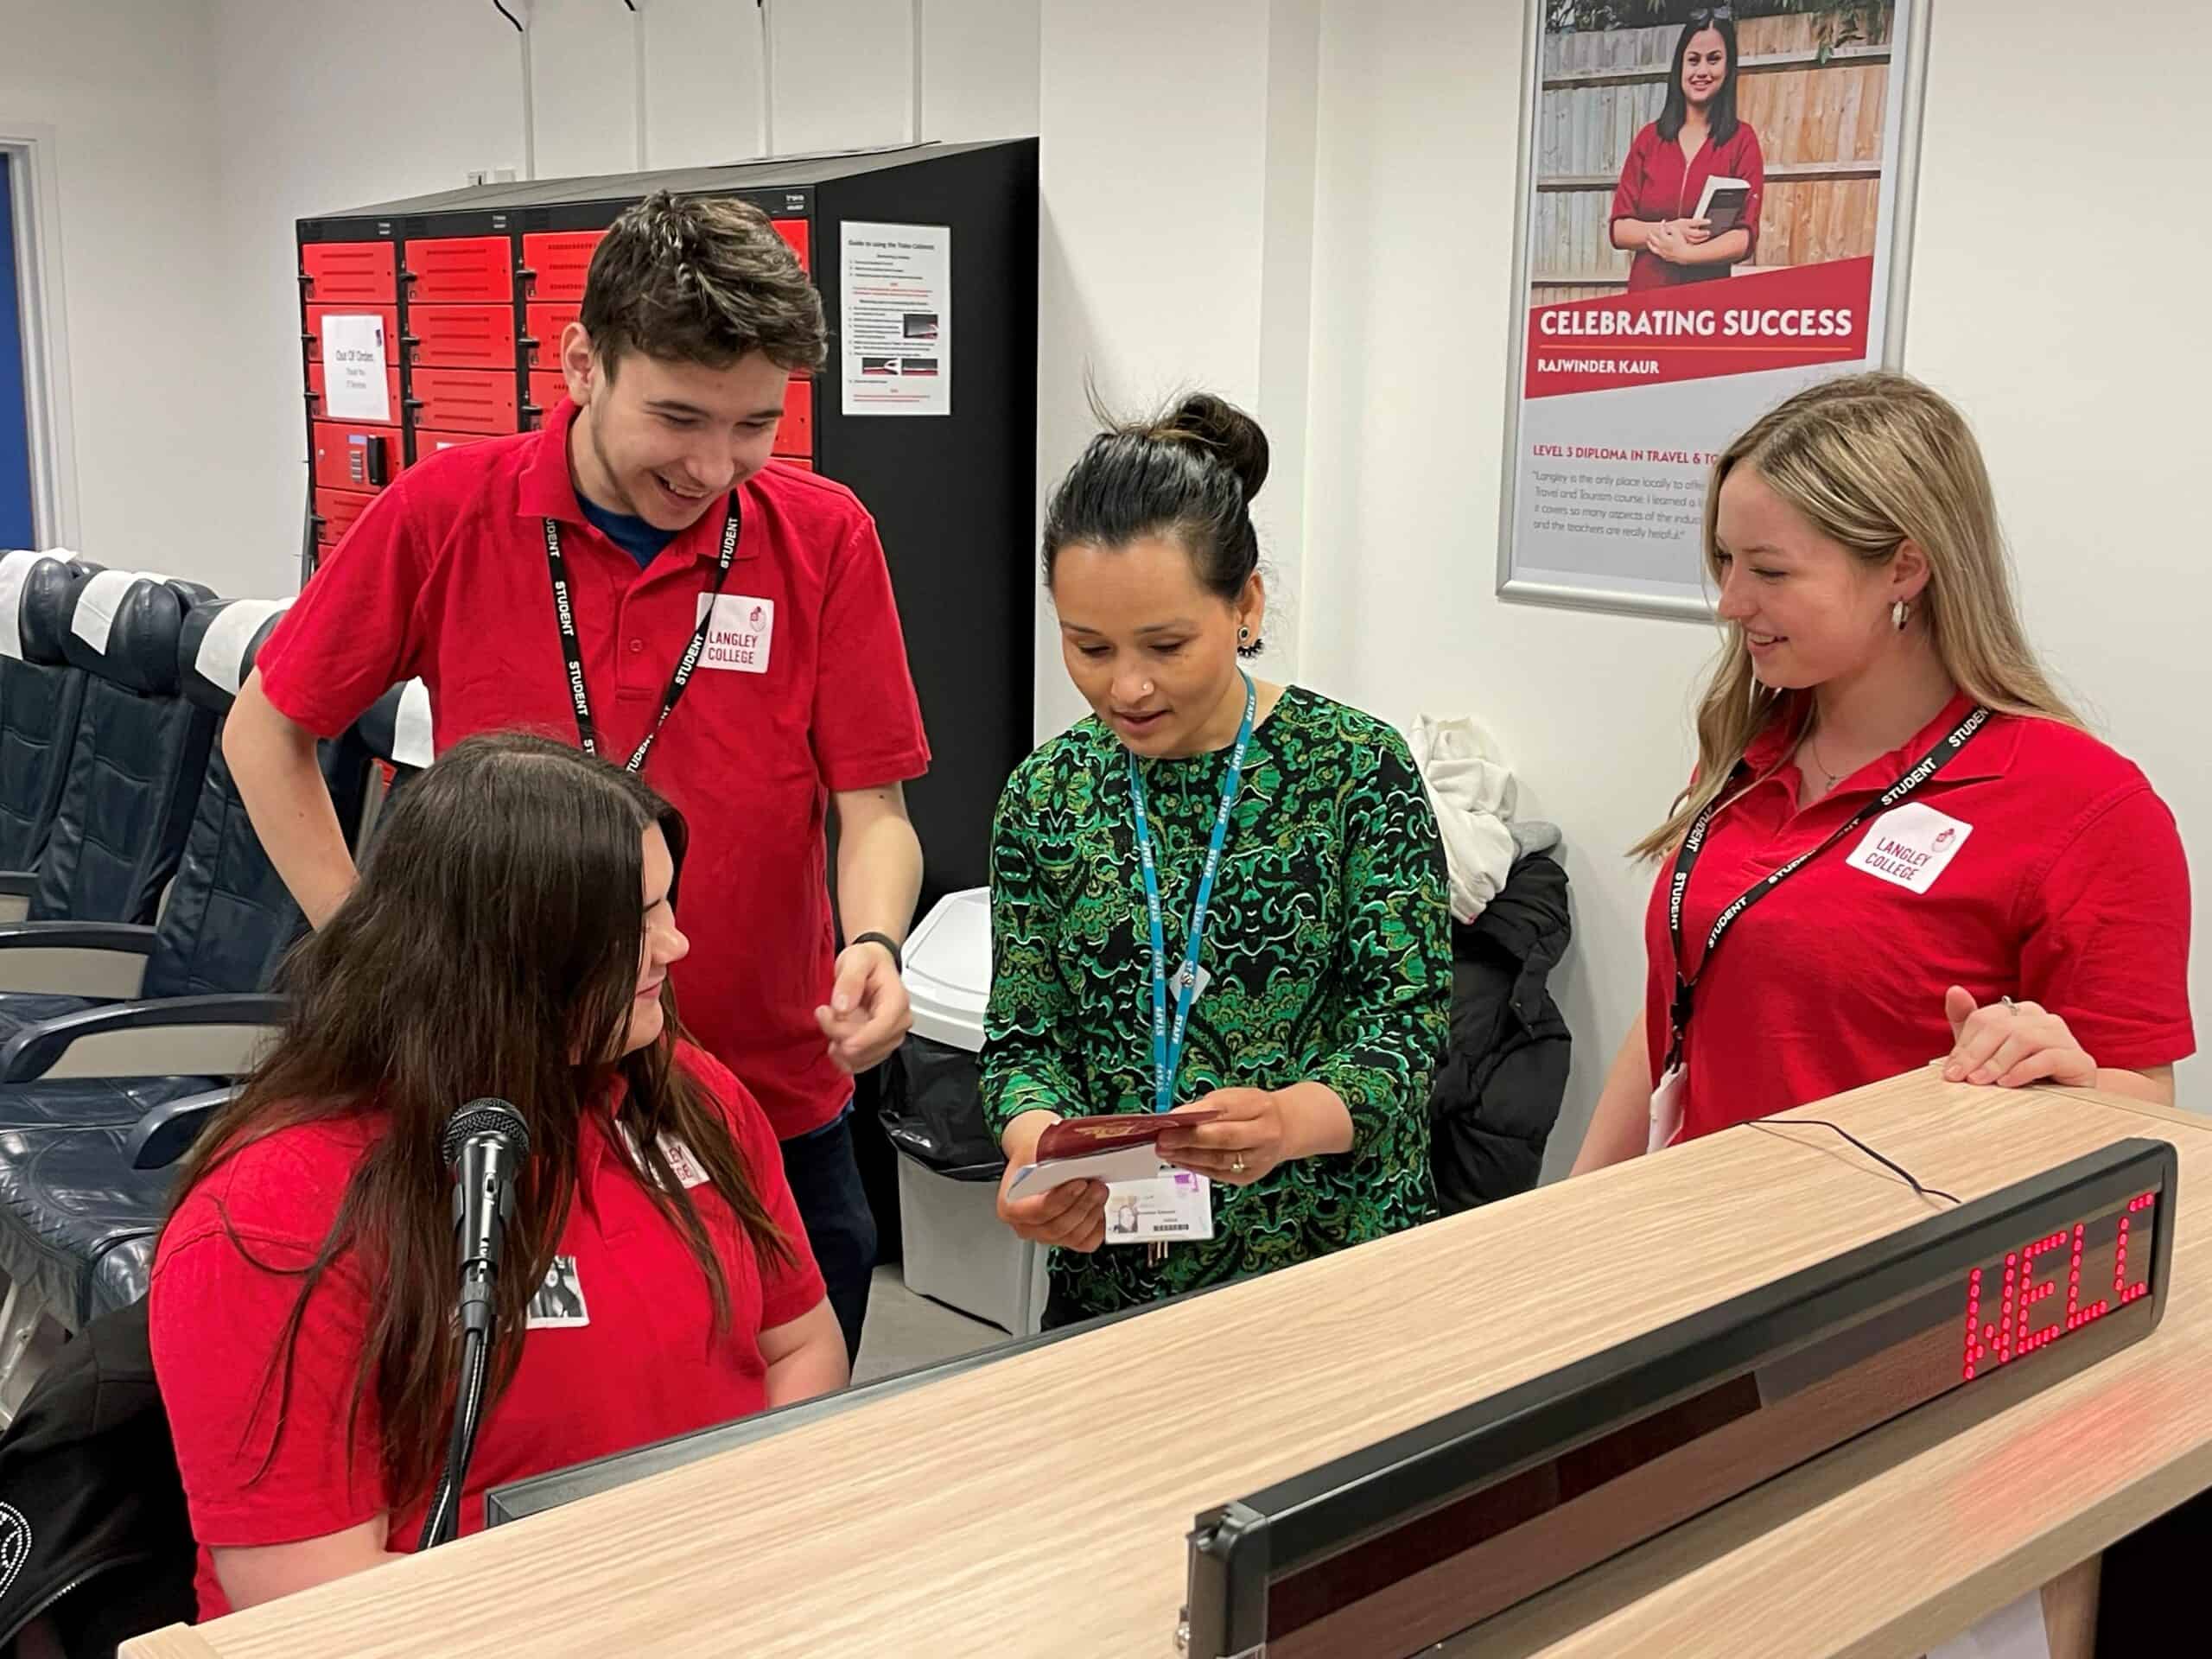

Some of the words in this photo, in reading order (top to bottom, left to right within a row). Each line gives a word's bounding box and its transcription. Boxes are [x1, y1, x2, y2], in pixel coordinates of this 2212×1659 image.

[1540, 310, 1715, 335] CELEBRATING
[1723, 309, 1853, 337] SUCCESS
[335, 349, 346, 361] Out
[1537, 359, 1616, 374] RAJWINDER
[1618, 360, 1659, 375] KAUR
[1533, 444, 1563, 458] LEVEL
[1575, 447, 1628, 461] DIPLOMA
[1630, 449, 1643, 461] IN
[1646, 450, 1689, 464] TRAVEL
[1692, 452, 1701, 465] &
[721, 516, 739, 569] STUDENT
[555, 581, 575, 637] STUDENT
[709, 631, 758, 649] LANGLEY
[675, 633, 703, 685] STUDENT
[708, 647, 754, 664] COLLEGE
[569, 661, 588, 716] STUDENT
[1948, 708, 1989, 747] STUDEN
[1231, 743, 1245, 772] STAFF
[1881, 757, 1936, 805] STUDENT
[1217, 795, 1230, 824] STAFF
[1141, 839, 1154, 869] STAFF
[1204, 849, 1217, 879] STAFF
[1865, 852, 1919, 880] COLLEGE
[1877, 836, 1932, 867] LANGLEY
[1670, 872, 1688, 931] STUDENT
[1707, 896, 1747, 949] STUDENT
[1154, 1006, 1165, 1036] STAFF
[1172, 1014, 1184, 1044] STAFF
